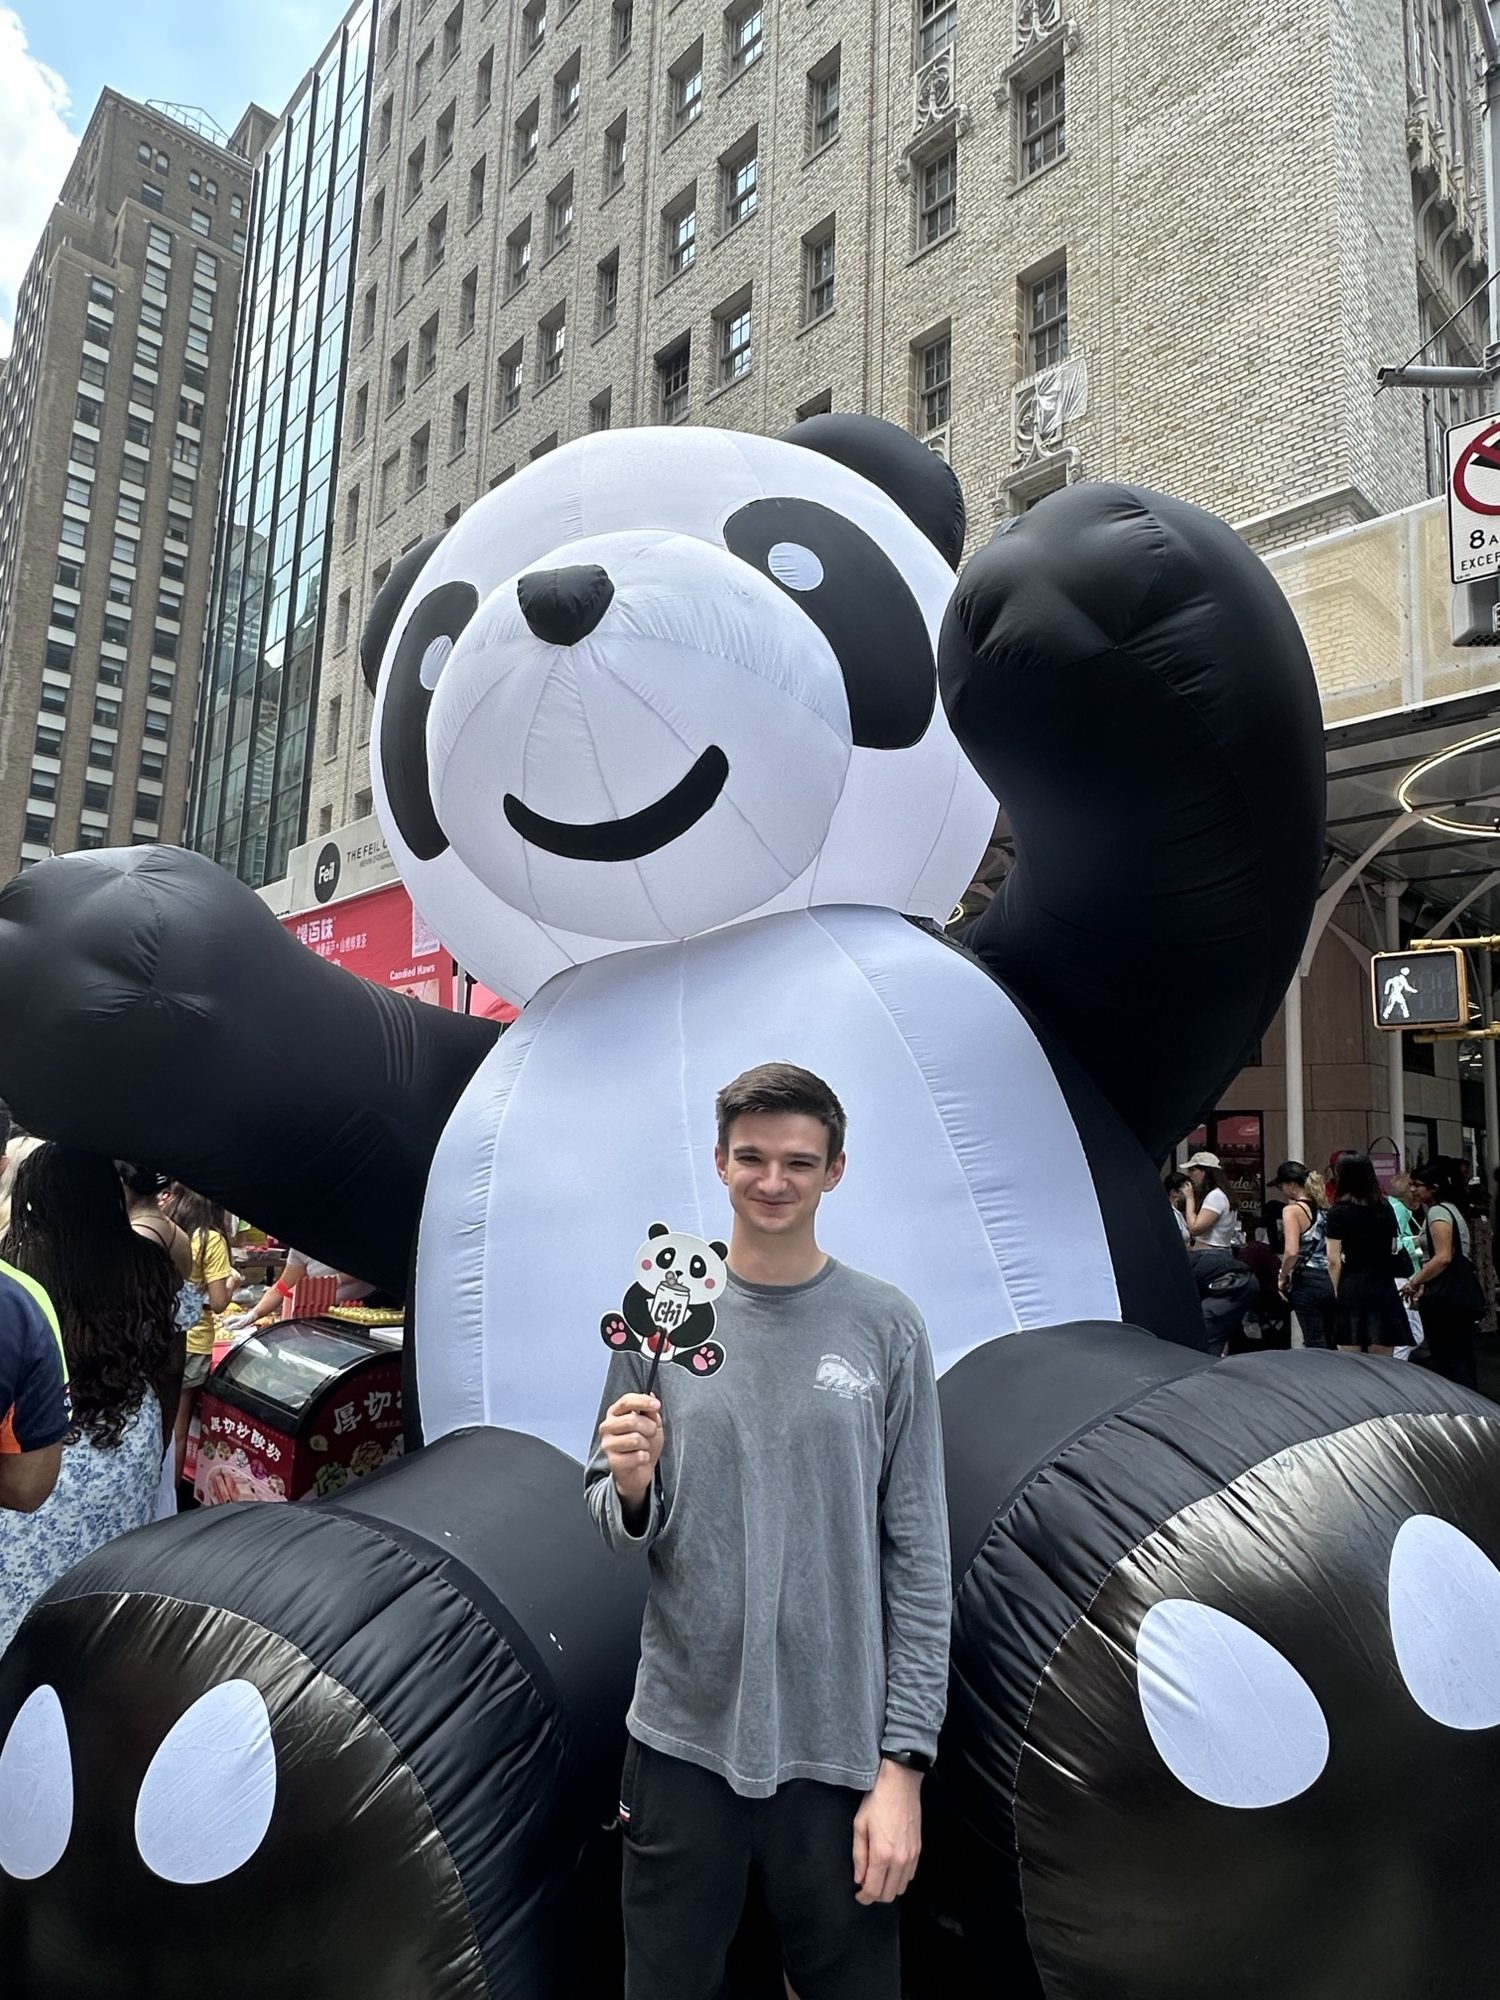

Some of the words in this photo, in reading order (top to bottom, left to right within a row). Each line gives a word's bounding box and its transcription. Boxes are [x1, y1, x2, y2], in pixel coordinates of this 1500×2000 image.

[346, 847, 362, 863] THE
[363, 840, 381, 857] FEIL
[318, 861, 335, 884] Feil
[390, 966, 416, 981] Candied
[417, 964, 436, 975] Haws
[654, 1300, 682, 1326] Chi
